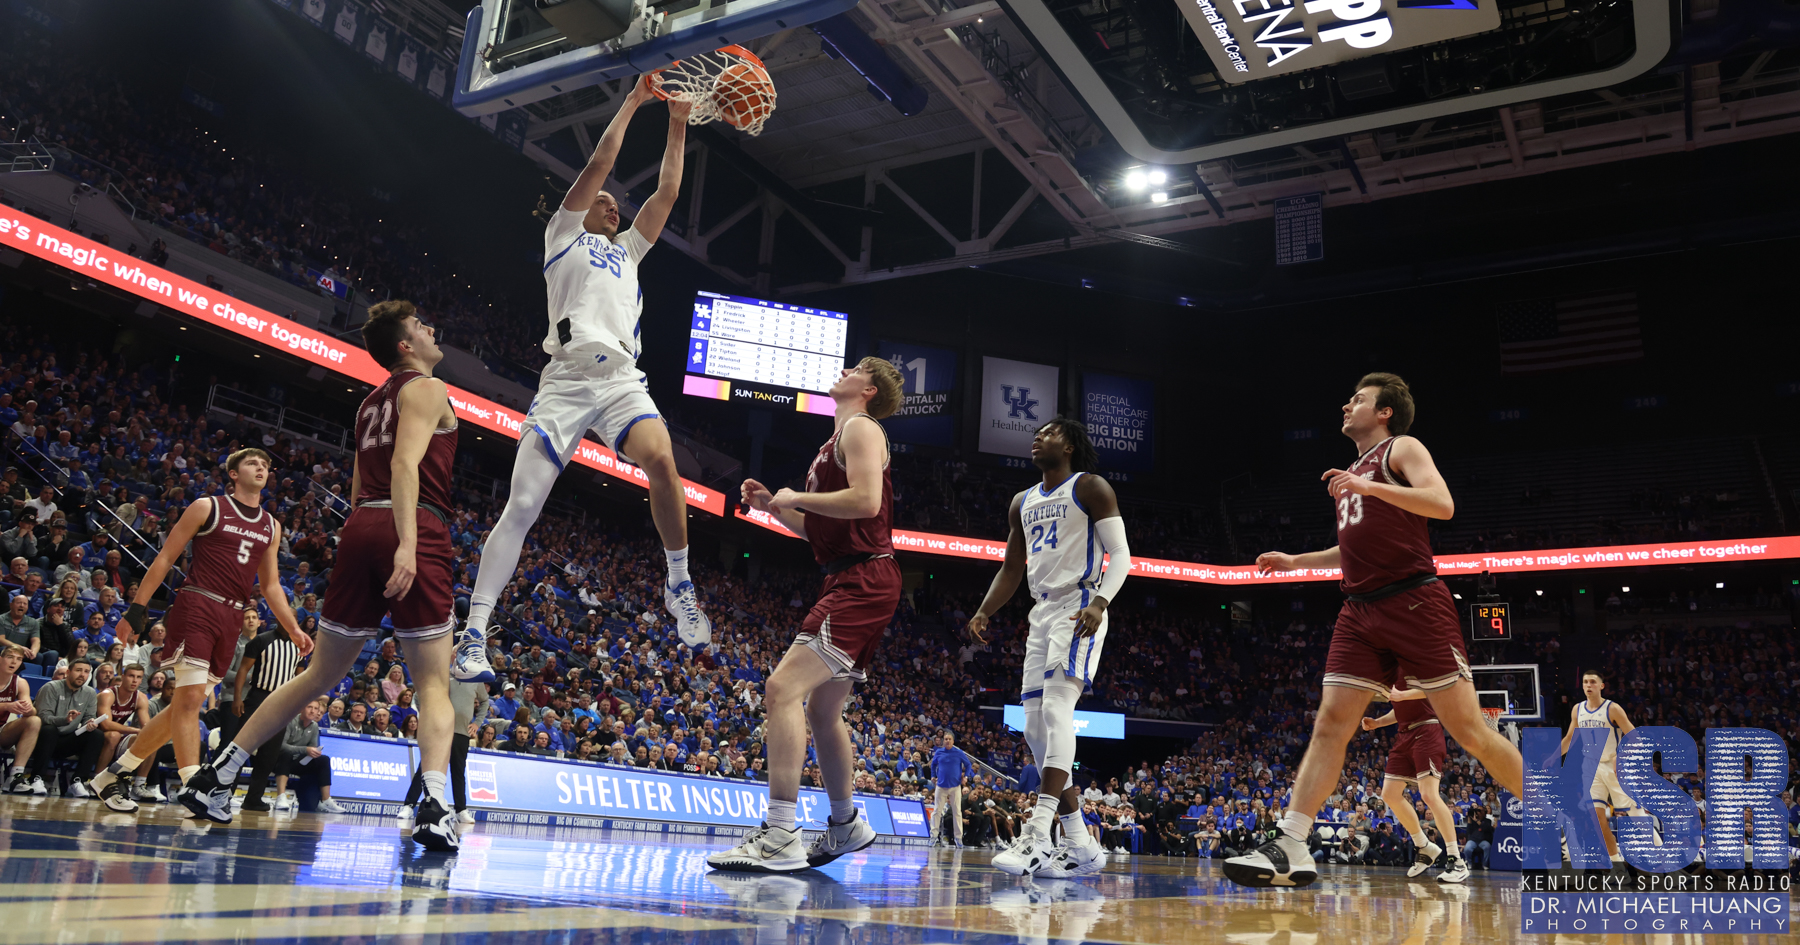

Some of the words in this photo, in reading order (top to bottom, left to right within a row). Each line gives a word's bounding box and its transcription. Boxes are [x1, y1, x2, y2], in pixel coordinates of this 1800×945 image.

[24, 6, 51, 26] 232
[1211, 22, 1234, 46] Bank
[1224, 45, 1248, 72] Center
[192, 94, 215, 112] 233
[1276, 202, 1319, 213] CHEERLEADING
[1276, 208, 1320, 220] CHAMPIONSHIPS
[589, 248, 621, 278] 55
[36, 232, 109, 271] magic
[114, 262, 173, 296] when
[178, 287, 208, 310] we
[213, 303, 268, 332] cheer
[271, 322, 347, 364] together
[722, 325, 750, 333] Livingston
[270, 387, 284, 401] 32
[735, 389, 752, 398] SUN
[753, 391, 772, 401] TAN
[772, 394, 792, 404] CITY
[900, 394, 933, 405] SPITAL
[936, 394, 947, 402] IN
[1087, 392, 1130, 406] OFFICIAL
[892, 404, 943, 416] ENTUCKY
[1001, 384, 1039, 422] UK
[1087, 402, 1148, 418] HEALTHCARE
[1634, 397, 1658, 408] 240
[449, 396, 466, 410] Real
[467, 404, 490, 419] Magic
[495, 410, 522, 432] The
[1087, 413, 1130, 426] PARTNER
[1132, 419, 1146, 428] OF
[1500, 409, 1520, 420] 240
[361, 399, 393, 451] 22
[992, 419, 1037, 434] HealthCa
[1087, 423, 1109, 436] BIG
[1112, 427, 1144, 441] BLUE
[893, 444, 906, 453] 35
[1088, 436, 1137, 452] NATION
[582, 446, 613, 467] when
[616, 460, 632, 474] we
[1006, 458, 1026, 468] 236
[1108, 472, 1128, 482] 236
[684, 486, 707, 503] ether
[1023, 504, 1068, 528] KENTUCKY
[1338, 493, 1364, 531] 33
[222, 524, 270, 544] BELLARMINE
[1031, 520, 1058, 553] 24
[892, 534, 924, 546] when
[927, 539, 946, 549] we
[949, 541, 983, 553] cheer
[237, 539, 254, 565] 5
[1457, 561, 1479, 569] Magic
[1483, 555, 1534, 567] There's
[1537, 553, 1581, 566] magic
[1583, 550, 1623, 562] when
[1626, 551, 1650, 560] we
[1653, 548, 1695, 558] cheer
[1699, 544, 1768, 558] together
[1140, 560, 1180, 574] There's
[1183, 567, 1216, 580] magic
[1218, 568, 1250, 580] when
[1274, 569, 1309, 577] cheer
[1312, 568, 1343, 577] toge
[1491, 618, 1503, 635] 9
[331, 757, 361, 772] ORGAN
[363, 760, 370, 773] &
[371, 760, 406, 776] MORGAN
[469, 769, 493, 777] SHELTER
[684, 764, 697, 772] POSS
[556, 771, 676, 812] SHELTER
[682, 784, 814, 822] INSURAE
[364, 804, 382, 814] FARM
[486, 812, 514, 823] KENTUCKY
[514, 814, 528, 823] FARM
[529, 814, 549, 824] BUREAU
[556, 816, 564, 824] BIG
[565, 817, 572, 825] ON
[573, 818, 603, 827] COMMITMENT
[612, 820, 634, 830] KENTUCKY
[634, 822, 646, 830] FARM
[647, 823, 662, 831] BUREAU
[683, 825, 708, 834] COMMITMENT
[715, 826, 733, 835] KENTUCKY
[733, 827, 742, 836] FARM
